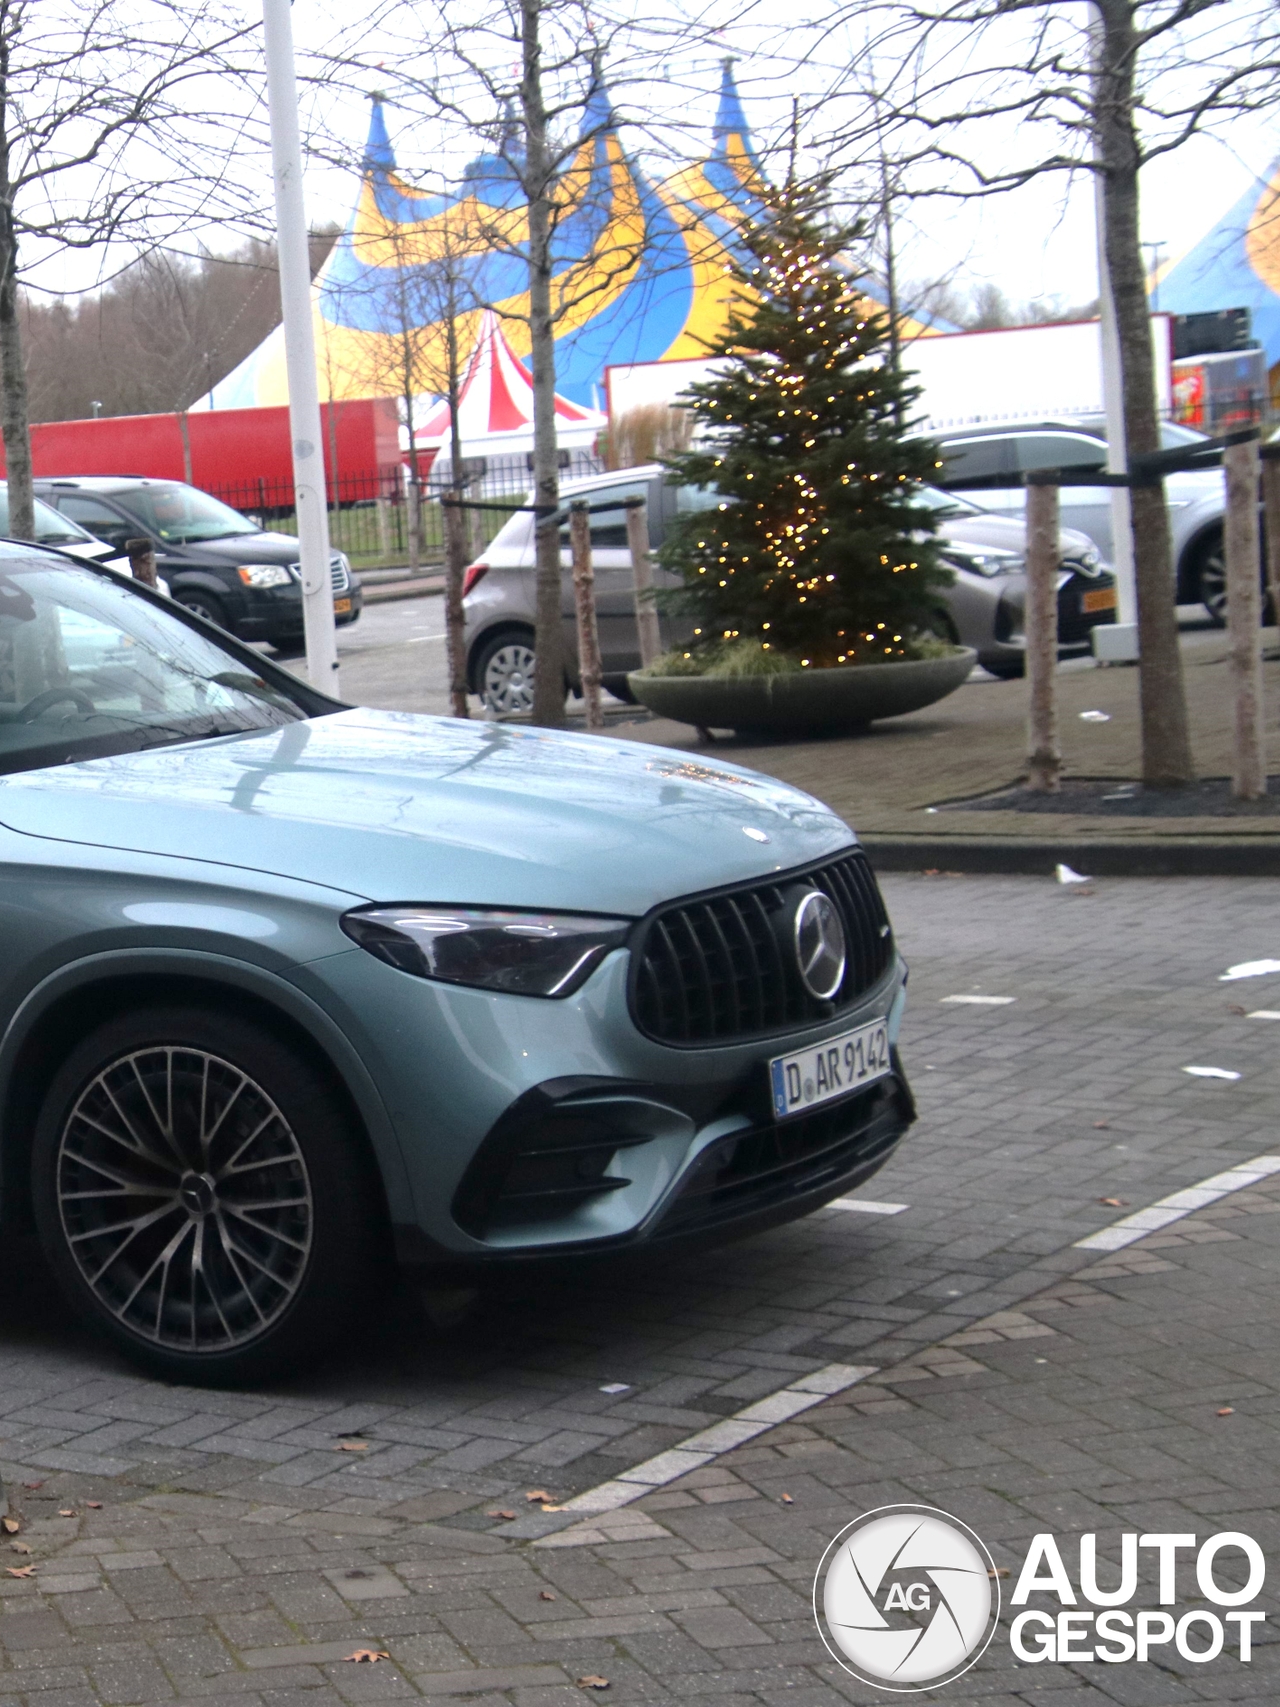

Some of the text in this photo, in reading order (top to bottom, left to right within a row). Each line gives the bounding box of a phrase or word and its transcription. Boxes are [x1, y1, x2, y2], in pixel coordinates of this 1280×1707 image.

[786, 1027, 887, 1105] D AR 9142
